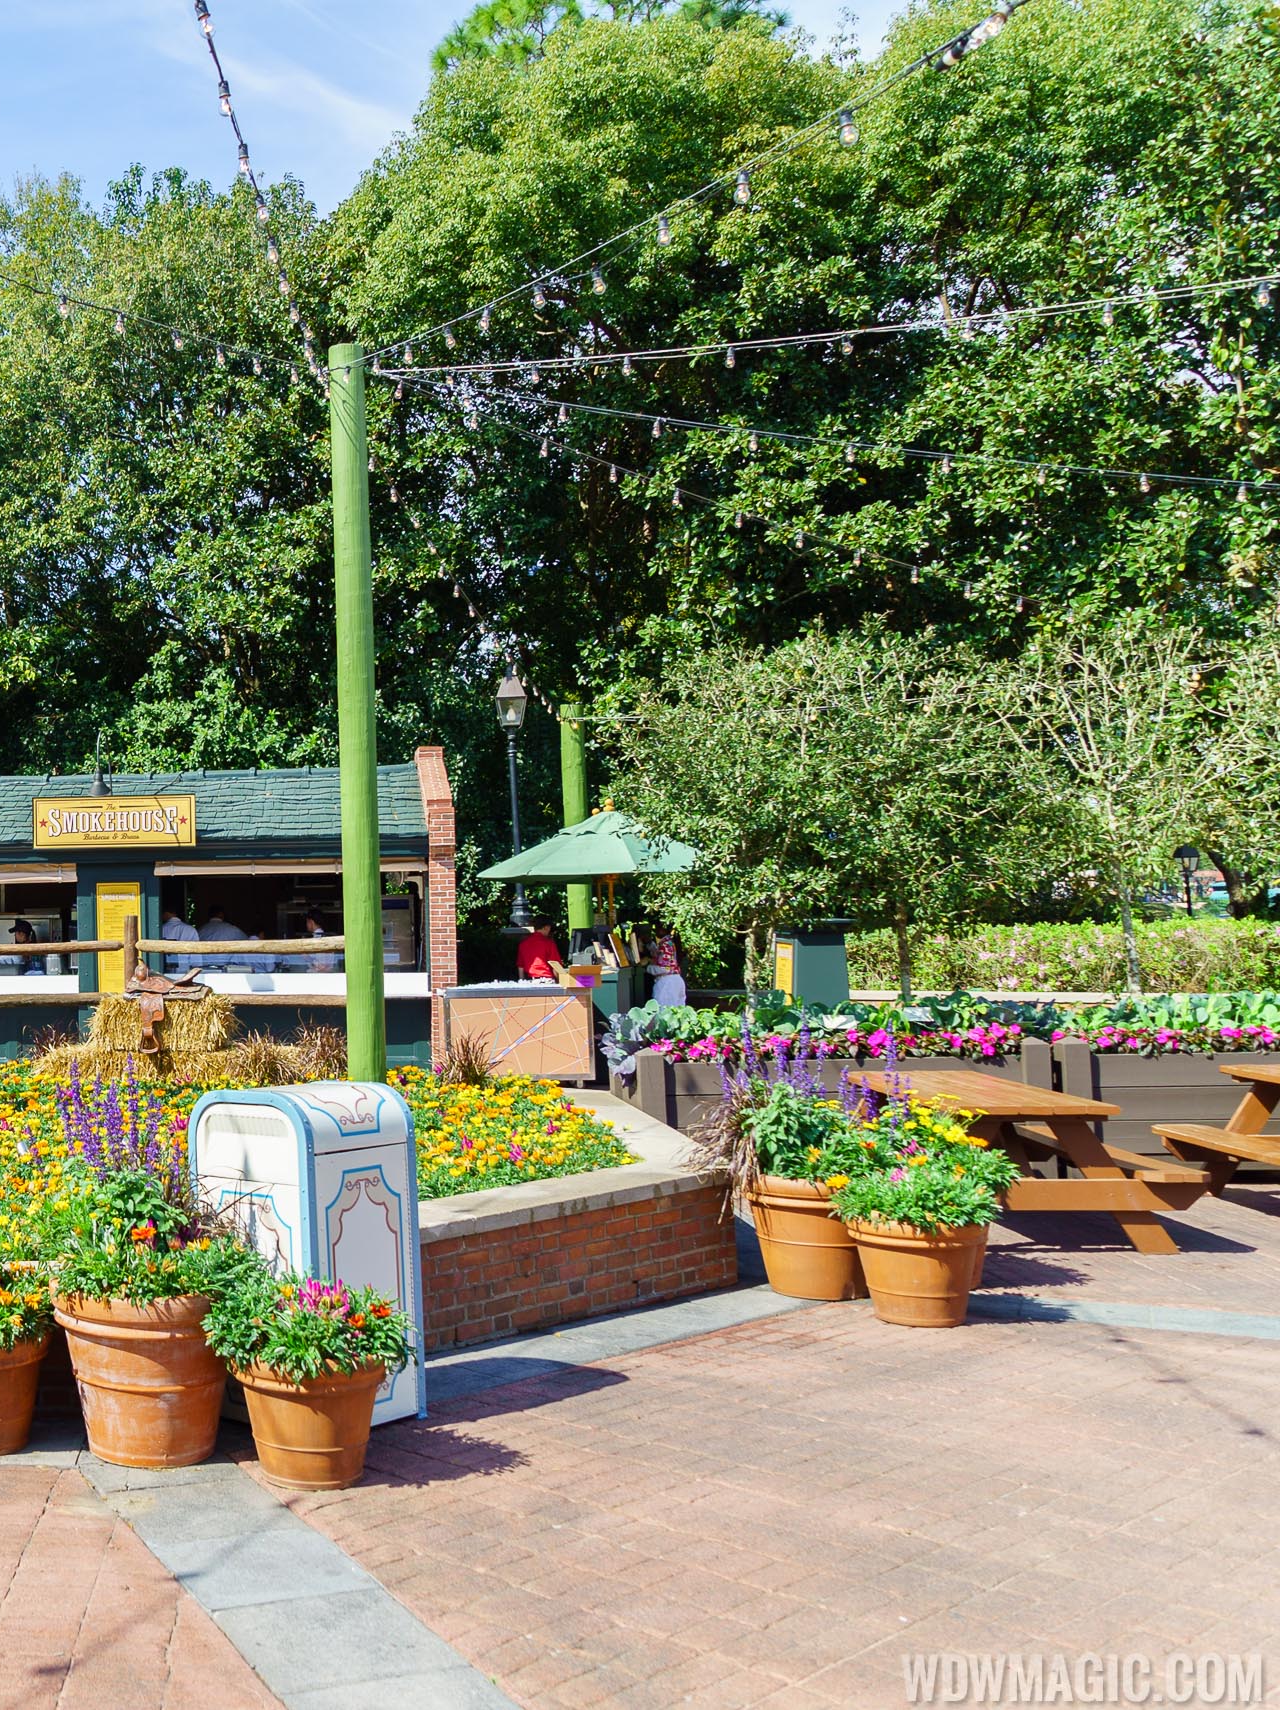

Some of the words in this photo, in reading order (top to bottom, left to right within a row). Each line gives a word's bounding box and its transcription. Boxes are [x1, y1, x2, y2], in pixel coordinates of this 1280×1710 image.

[106, 803, 116, 811] The
[48, 806, 178, 838] SMOKEHOUSE
[83, 833, 110, 841] Barbecue
